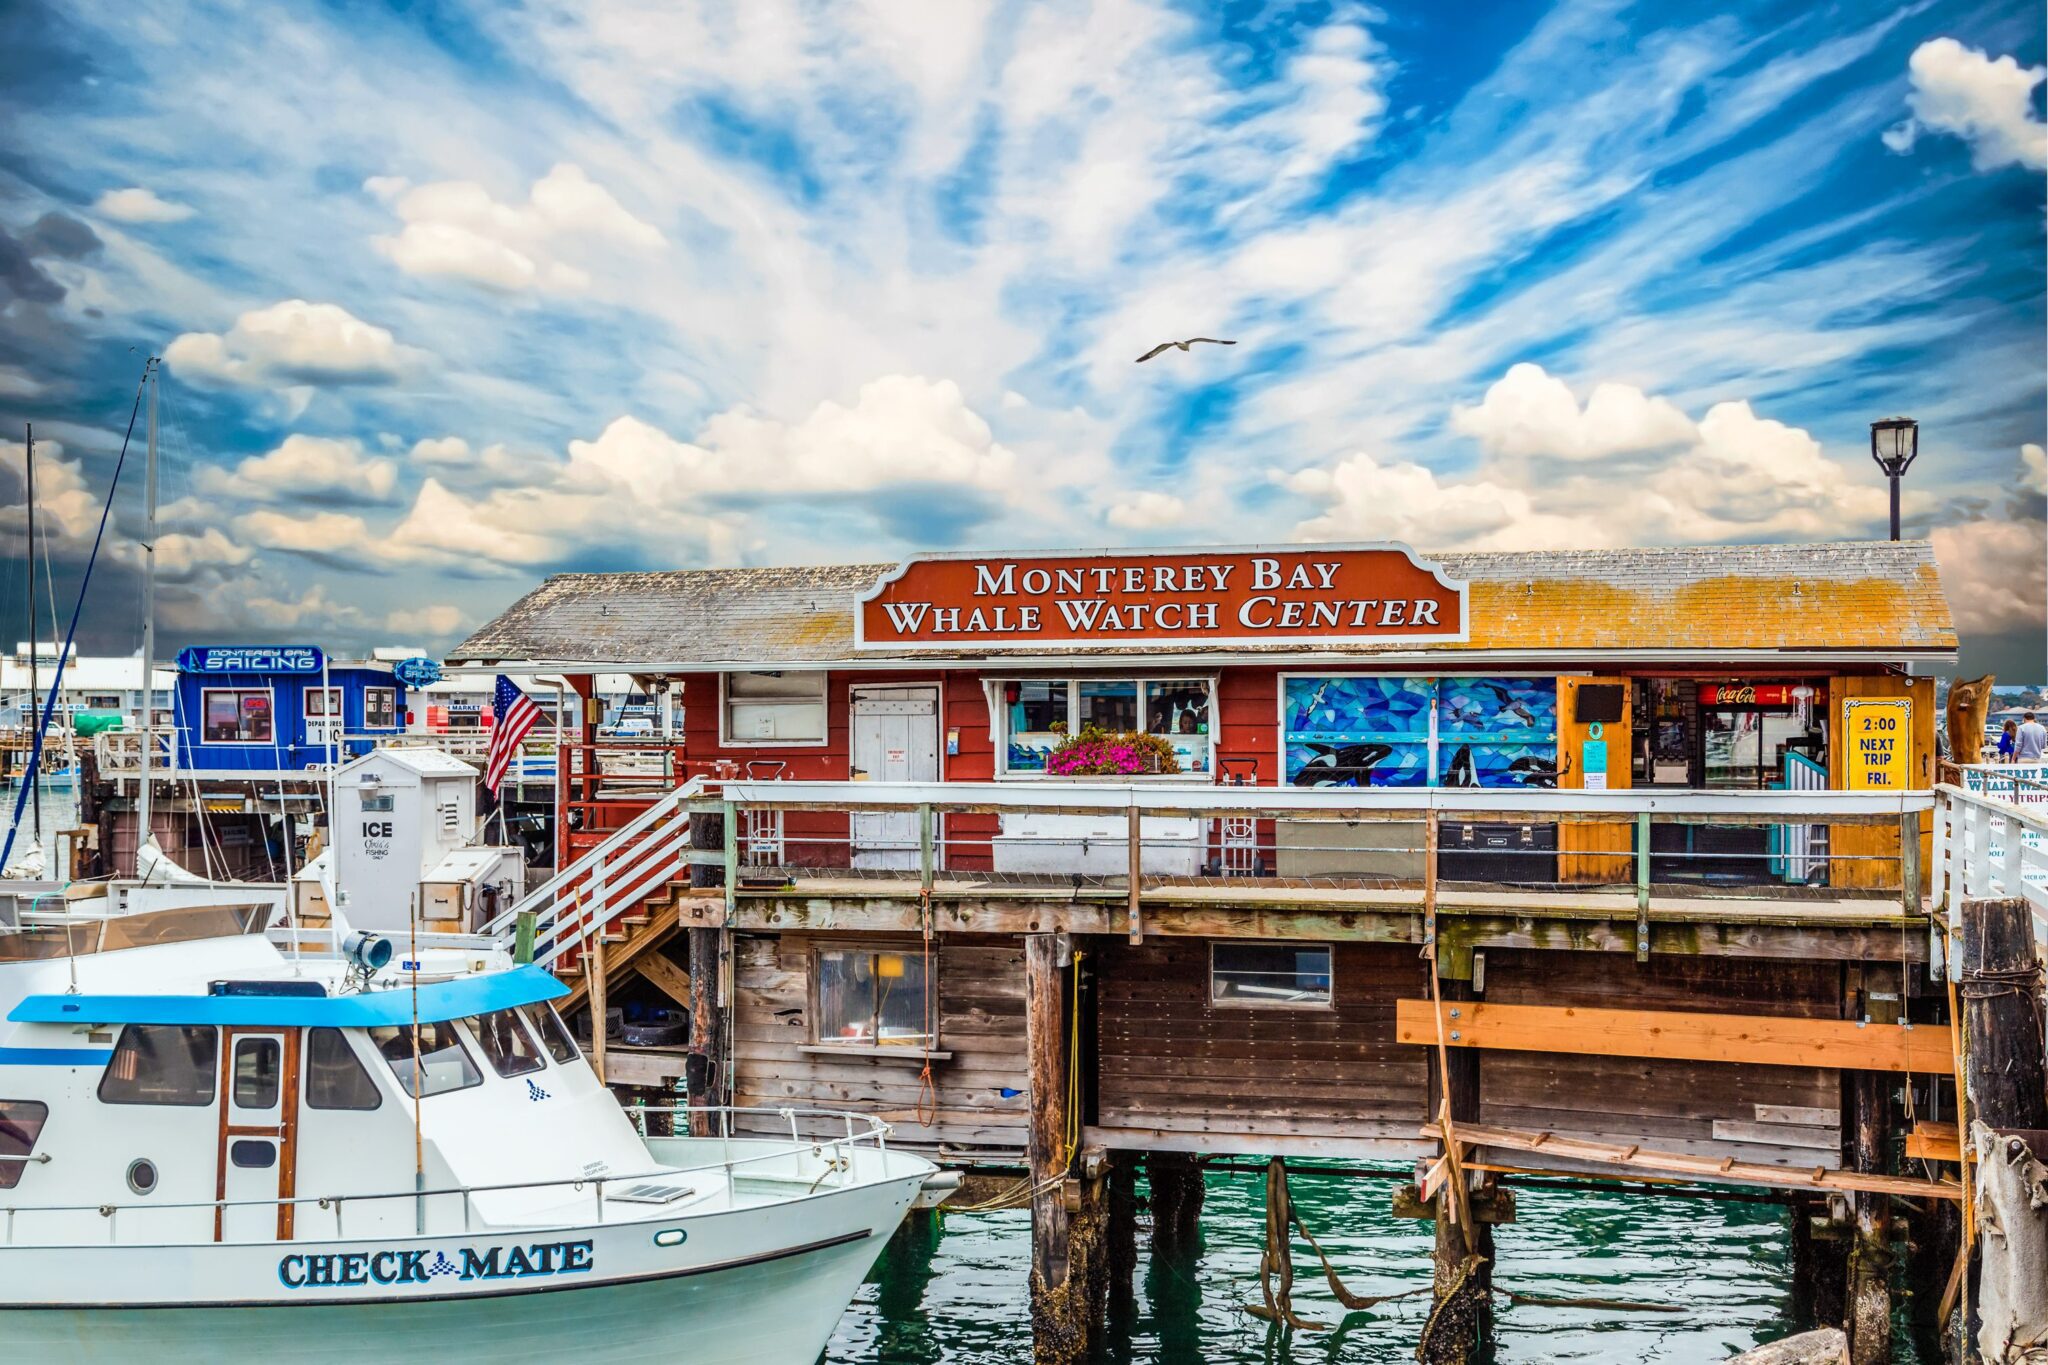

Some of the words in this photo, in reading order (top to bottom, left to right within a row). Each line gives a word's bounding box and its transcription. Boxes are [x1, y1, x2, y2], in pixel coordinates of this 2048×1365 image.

[973, 563, 1236, 597] MONTEREY
[1250, 558, 1342, 593] BAY
[882, 602, 1042, 634] WHALE
[1055, 599, 1220, 632] WATCH
[1237, 596, 1441, 630] CENTER
[208, 649, 281, 657] MONTEREY
[284, 649, 312, 657] BAY
[205, 657, 315, 669] SAILING
[404, 670, 439, 679] SAILING
[1863, 717, 1896, 731] 2:00
[1860, 738, 1895, 751] NEXT
[1864, 753, 1892, 766] TRIP
[1867, 772, 1892, 785] FRI.
[362, 821, 393, 838] ICE
[278, 1248, 431, 1289] CHECK
[458, 1239, 594, 1281] MATE
